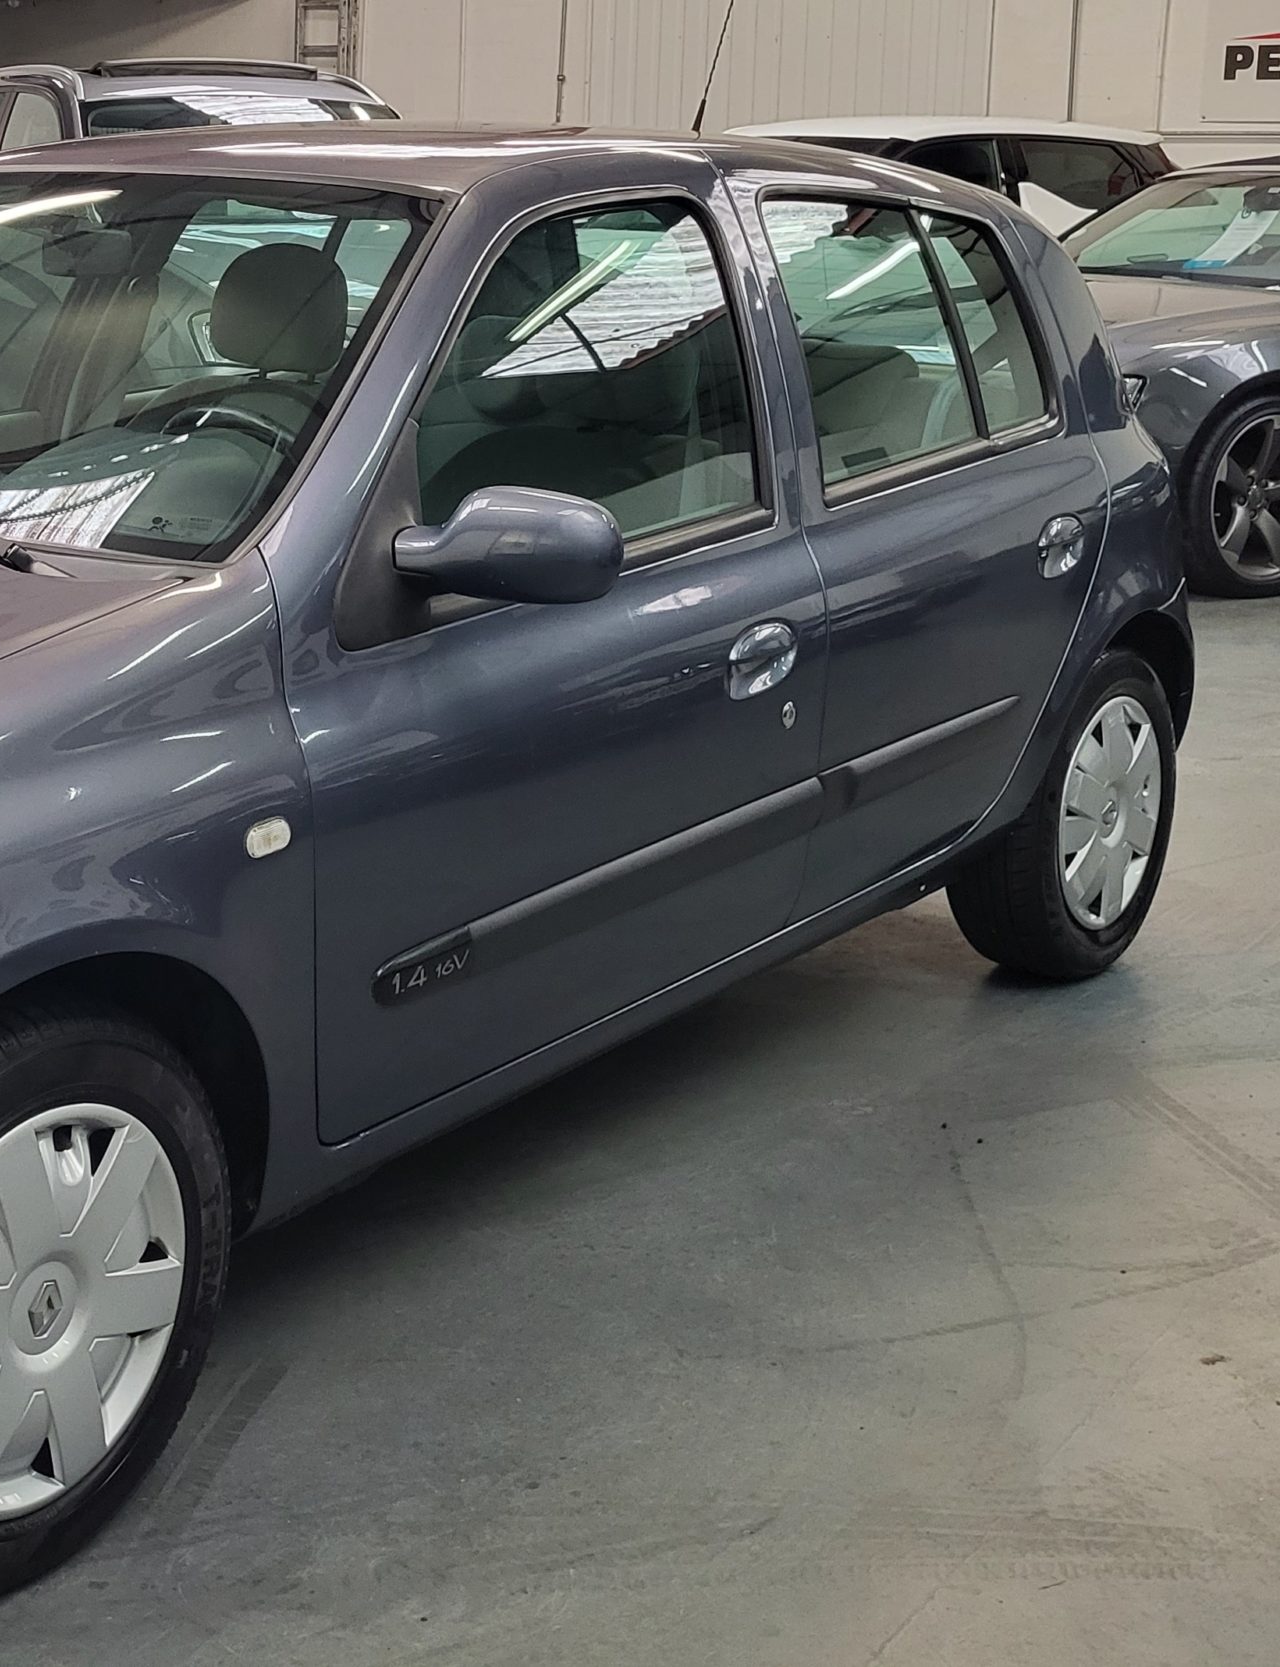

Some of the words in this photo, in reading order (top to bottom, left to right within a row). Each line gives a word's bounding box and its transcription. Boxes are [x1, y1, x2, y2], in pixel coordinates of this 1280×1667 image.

[1223, 45, 1280, 80] PE
[392, 965, 428, 994] 1.4
[435, 949, 470, 978] 16V
